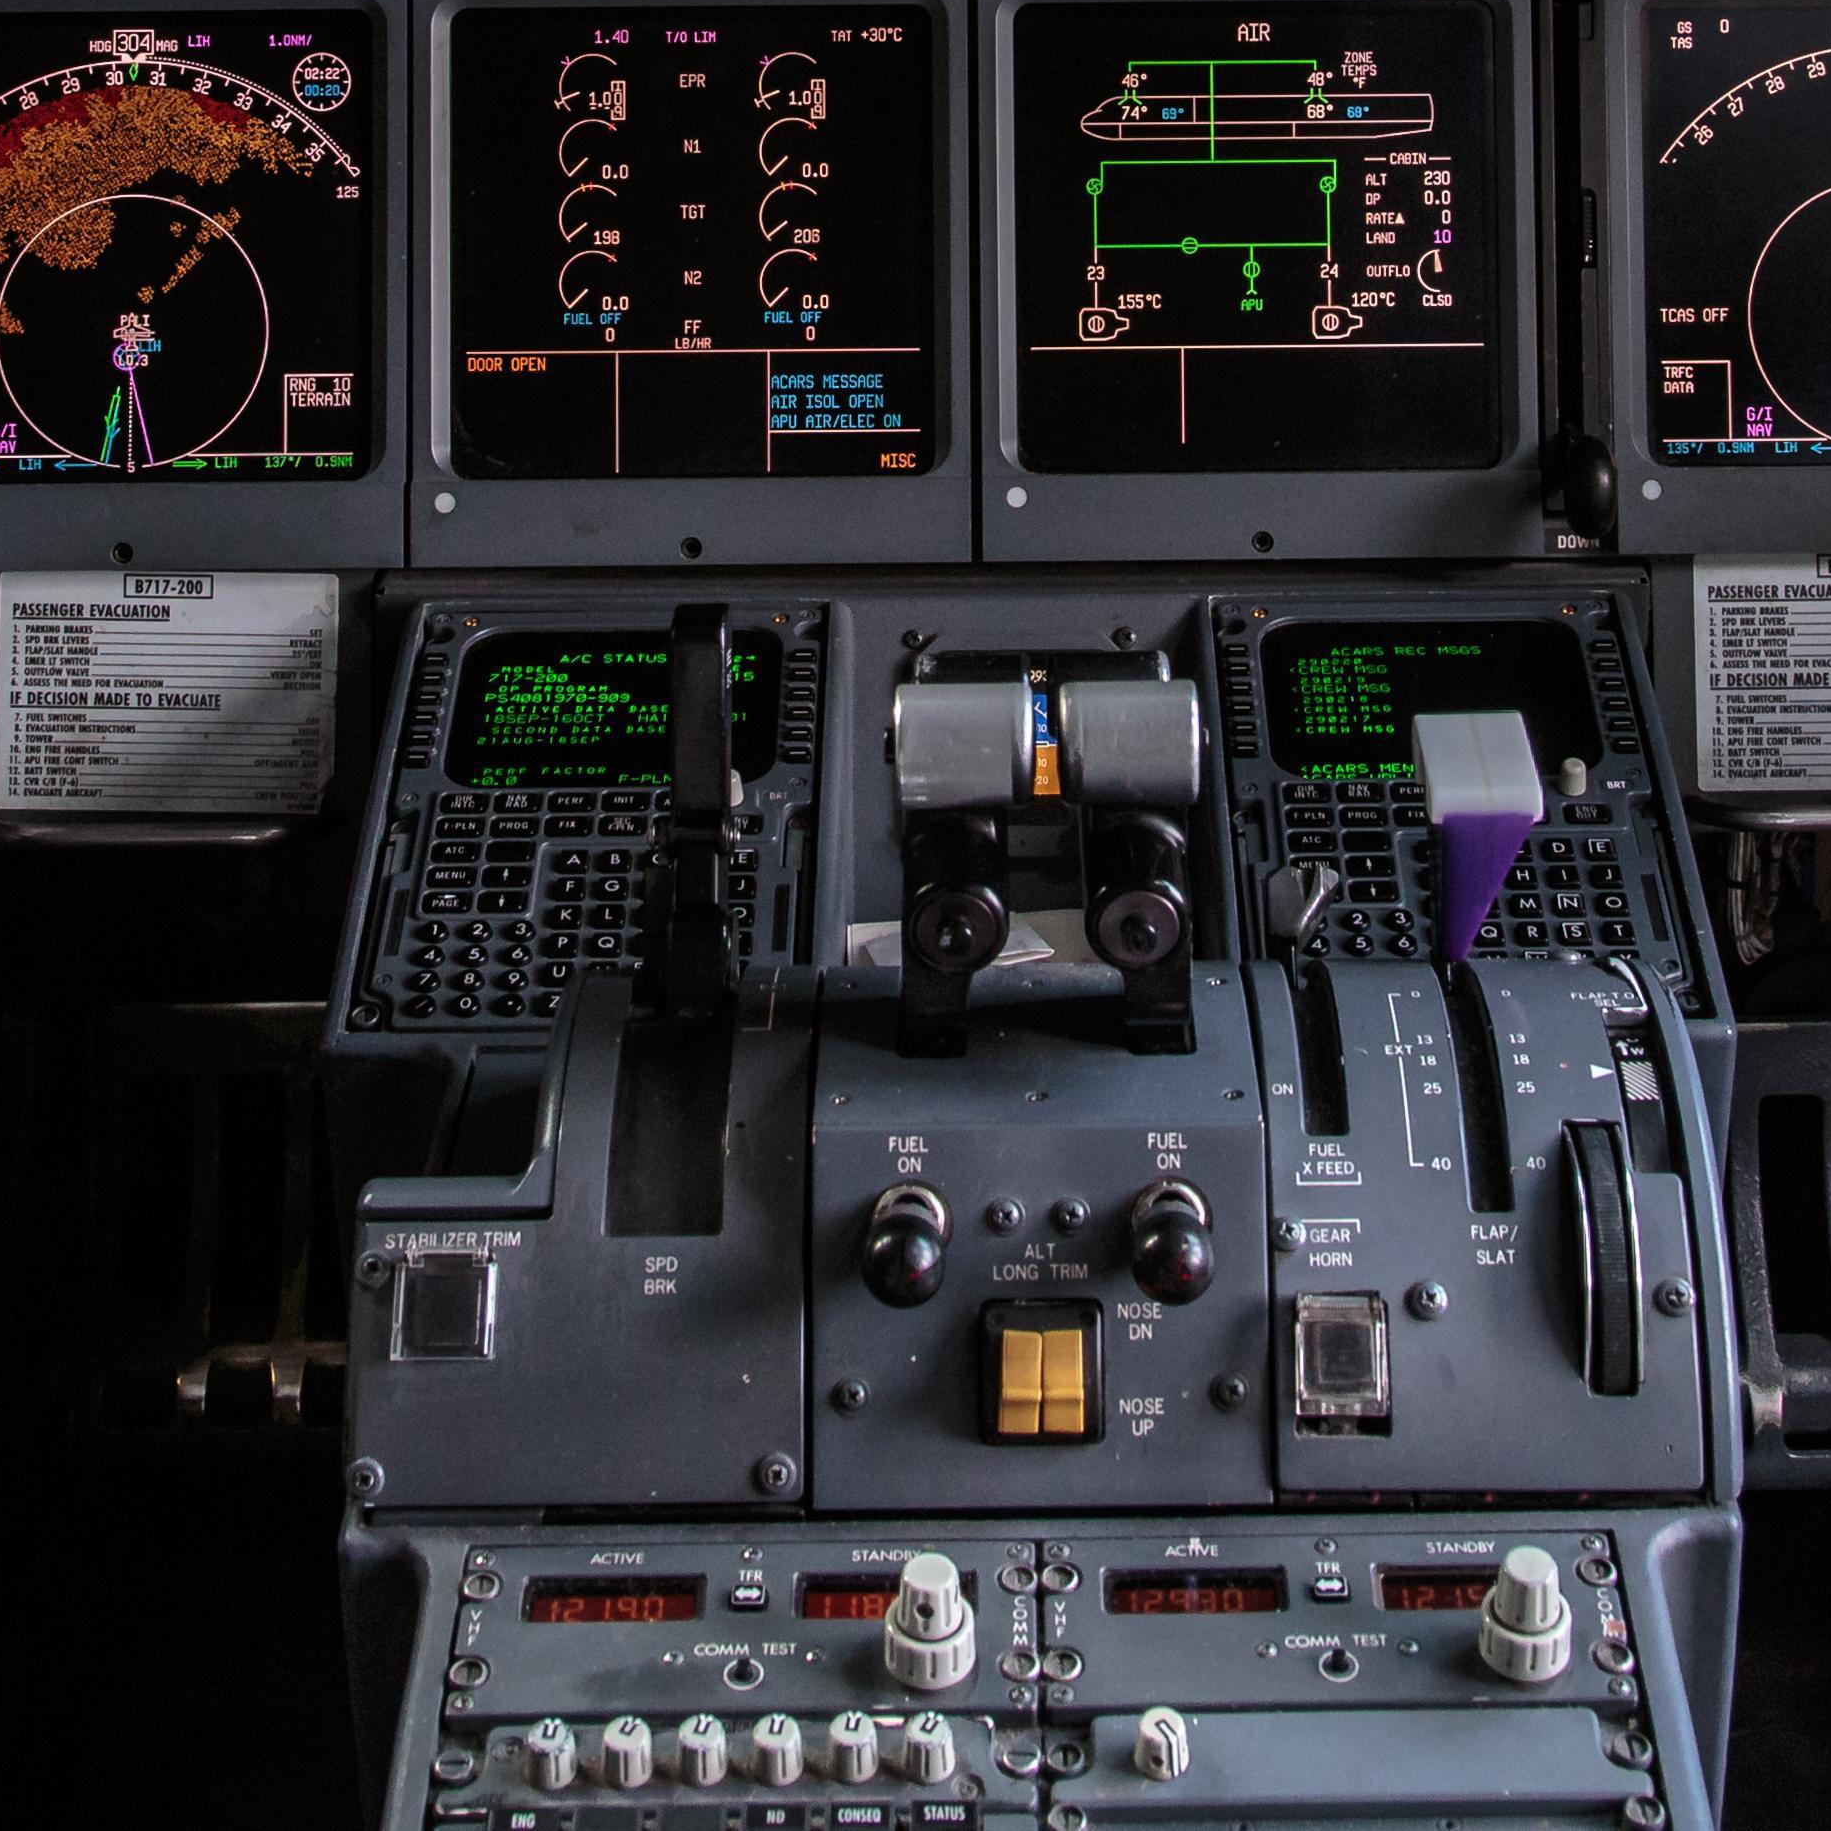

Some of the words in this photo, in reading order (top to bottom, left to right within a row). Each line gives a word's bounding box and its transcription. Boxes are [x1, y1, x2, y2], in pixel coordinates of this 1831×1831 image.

[666, 31, 688, 43] T/O
[694, 31, 716, 43] LIM
[1237, 23, 1271, 42] AIR
[89, 40, 112, 52] HDG
[117, 34, 151, 53] 304
[156, 40, 178, 52] MAG
[1341, 65, 1377, 77] TEMPS
[679, 74, 705, 88] EPR
[1390, 153, 1426, 165] CABIN
[1424, 171, 1451, 186] 230
[680, 205, 705, 219] TGT
[593, 230, 620, 245] 198
[793, 229, 820, 244] 206
[1366, 265, 1410, 277] OUTFLO
[1422, 295, 1452, 307] CLSD
[1660, 308, 1695, 322] TCAS
[1703, 307, 1729, 322] OFF
[468, 358, 503, 372] DOOR
[511, 357, 546, 371] OPEN
[770, 375, 815, 389] ACARS
[822, 374, 883, 389] MESSAGE
[290, 393, 351, 407] TERRAIN
[771, 395, 797, 409] AIR
[805, 394, 841, 409] ISOL
[849, 394, 884, 409] OPEN
[770, 415, 798, 429] APU
[806, 414, 875, 429] AIR/ELEC
[883, 414, 901, 428] ON
[880, 453, 916, 468] MISC
[135, 580, 204, 595] B717-200
[1708, 585, 1779, 599] PASSENGER
[12, 603, 85, 618] PASSENGER
[89, 603, 170, 619] EVACUATION
[559, 653, 596, 664] A/C
[603, 653, 667, 664] STATUS
[1710, 673, 1721, 687] IF
[1727, 673, 1788, 686] DECISION
[1793, 672, 1830, 686] MADE
[10, 692, 22, 705] IF
[27, 692, 89, 706] DECISION
[93, 692, 130, 706] MADE
[136, 693, 152, 707] TO
[158, 693, 221, 708] EVACUATE
[1470, 1224, 1518, 1242] FLAP/
[644, 1256, 678, 1274] SPD
[1309, 1251, 1353, 1267] HORN
[1476, 1249, 1515, 1266] SLAT
[992, 1263, 1040, 1281] LONG
[1050, 1263, 1088, 1281] TRIM
[643, 1278, 677, 1296] BRK
[1117, 1302, 1163, 1320] NOSE
[1425, 1539, 1495, 1556] STANDBY
[590, 1551, 645, 1566] ACTIVE
[693, 1643, 750, 1658] COMM
[762, 1643, 797, 1658] TEST
[923, 1805, 966, 1823] STATUS
